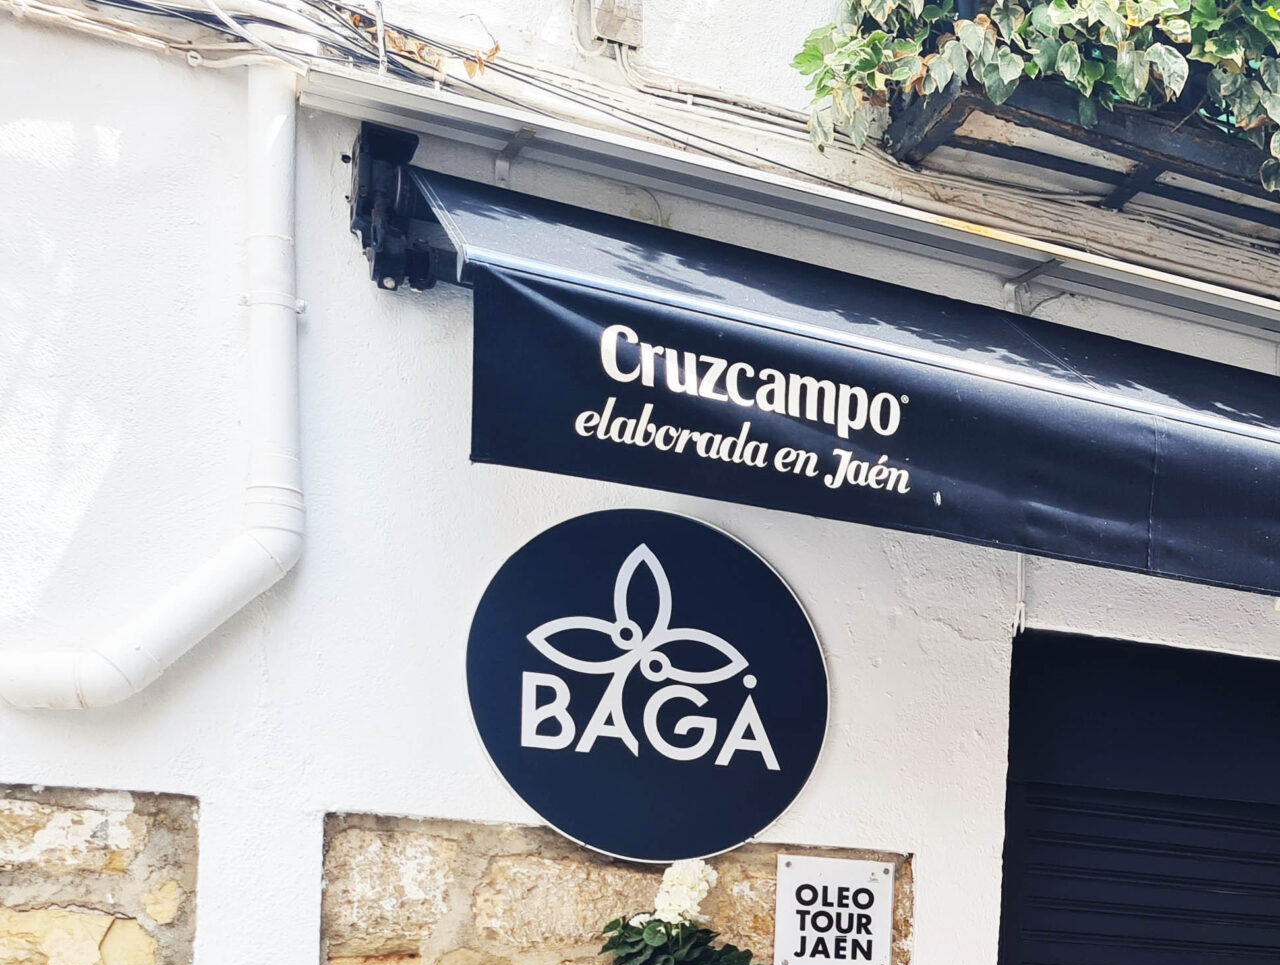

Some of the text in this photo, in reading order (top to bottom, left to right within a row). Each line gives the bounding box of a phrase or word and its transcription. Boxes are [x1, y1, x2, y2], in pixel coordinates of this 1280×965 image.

[574, 397, 911, 494] elaborada en Jaén
[795, 884, 875, 910] OLEO
[795, 910, 873, 935] TOUR
